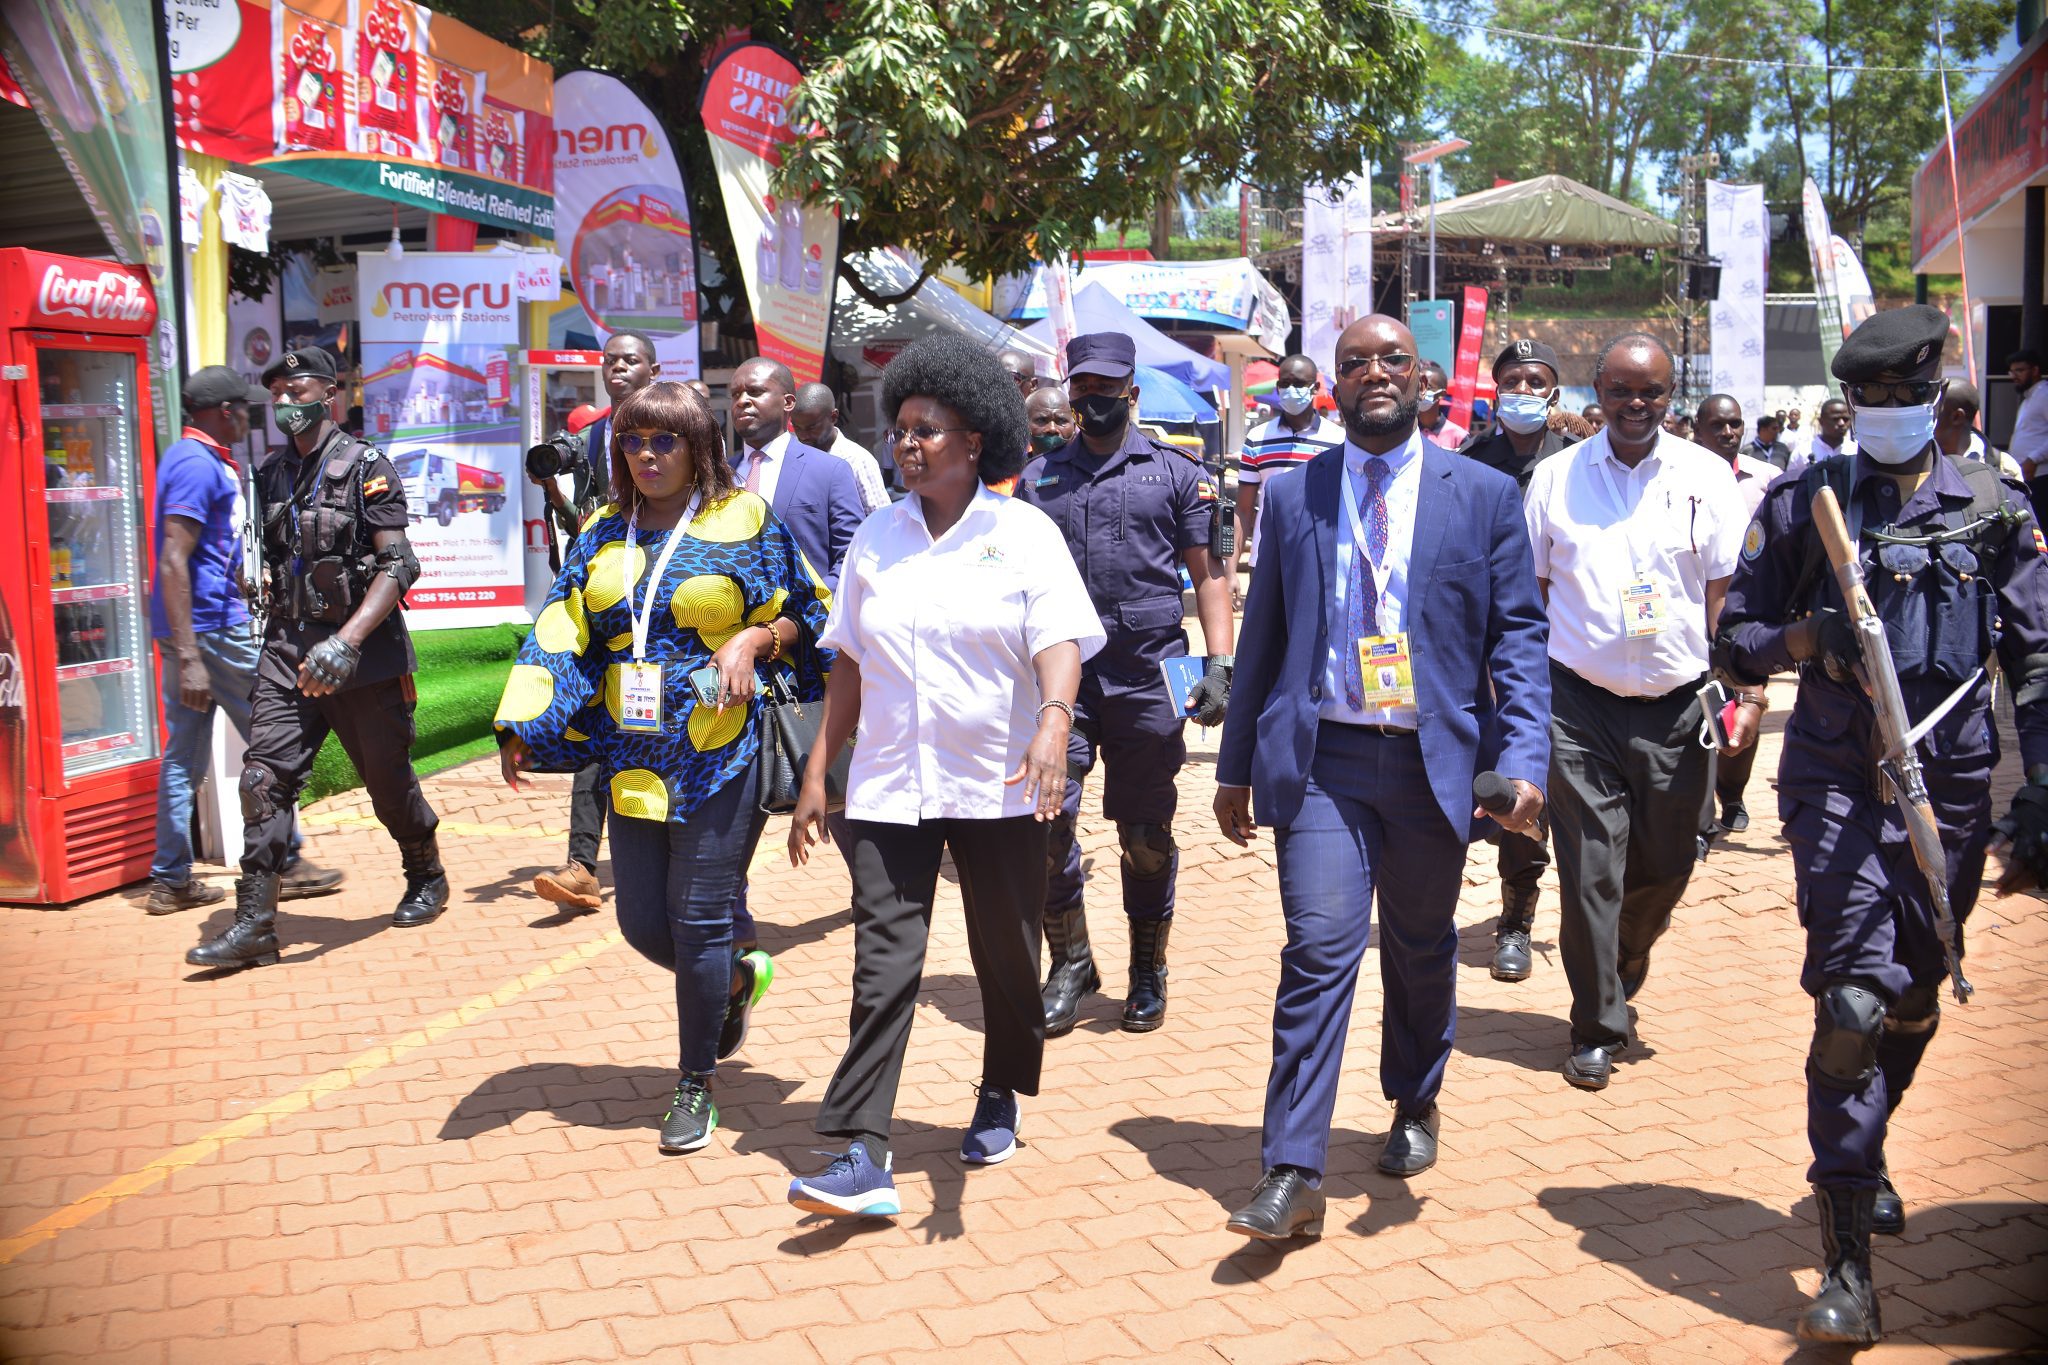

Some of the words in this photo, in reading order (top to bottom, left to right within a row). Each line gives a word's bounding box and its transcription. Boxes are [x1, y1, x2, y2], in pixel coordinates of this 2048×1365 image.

[175, 11, 200, 31] Per
[379, 163, 435, 199] Fortified
[436, 180, 488, 212] Blended
[488, 194, 532, 224] Refined
[38, 264, 147, 321] Coca-Cola
[382, 281, 510, 310] meru
[393, 311, 458, 323] Petroleum
[461, 311, 511, 323] Stations
[554, 354, 587, 363] DIESEL
[412, 592, 437, 602] +256
[437, 592, 457, 602] 754
[458, 591, 477, 601] 022
[477, 590, 496, 600] 220
